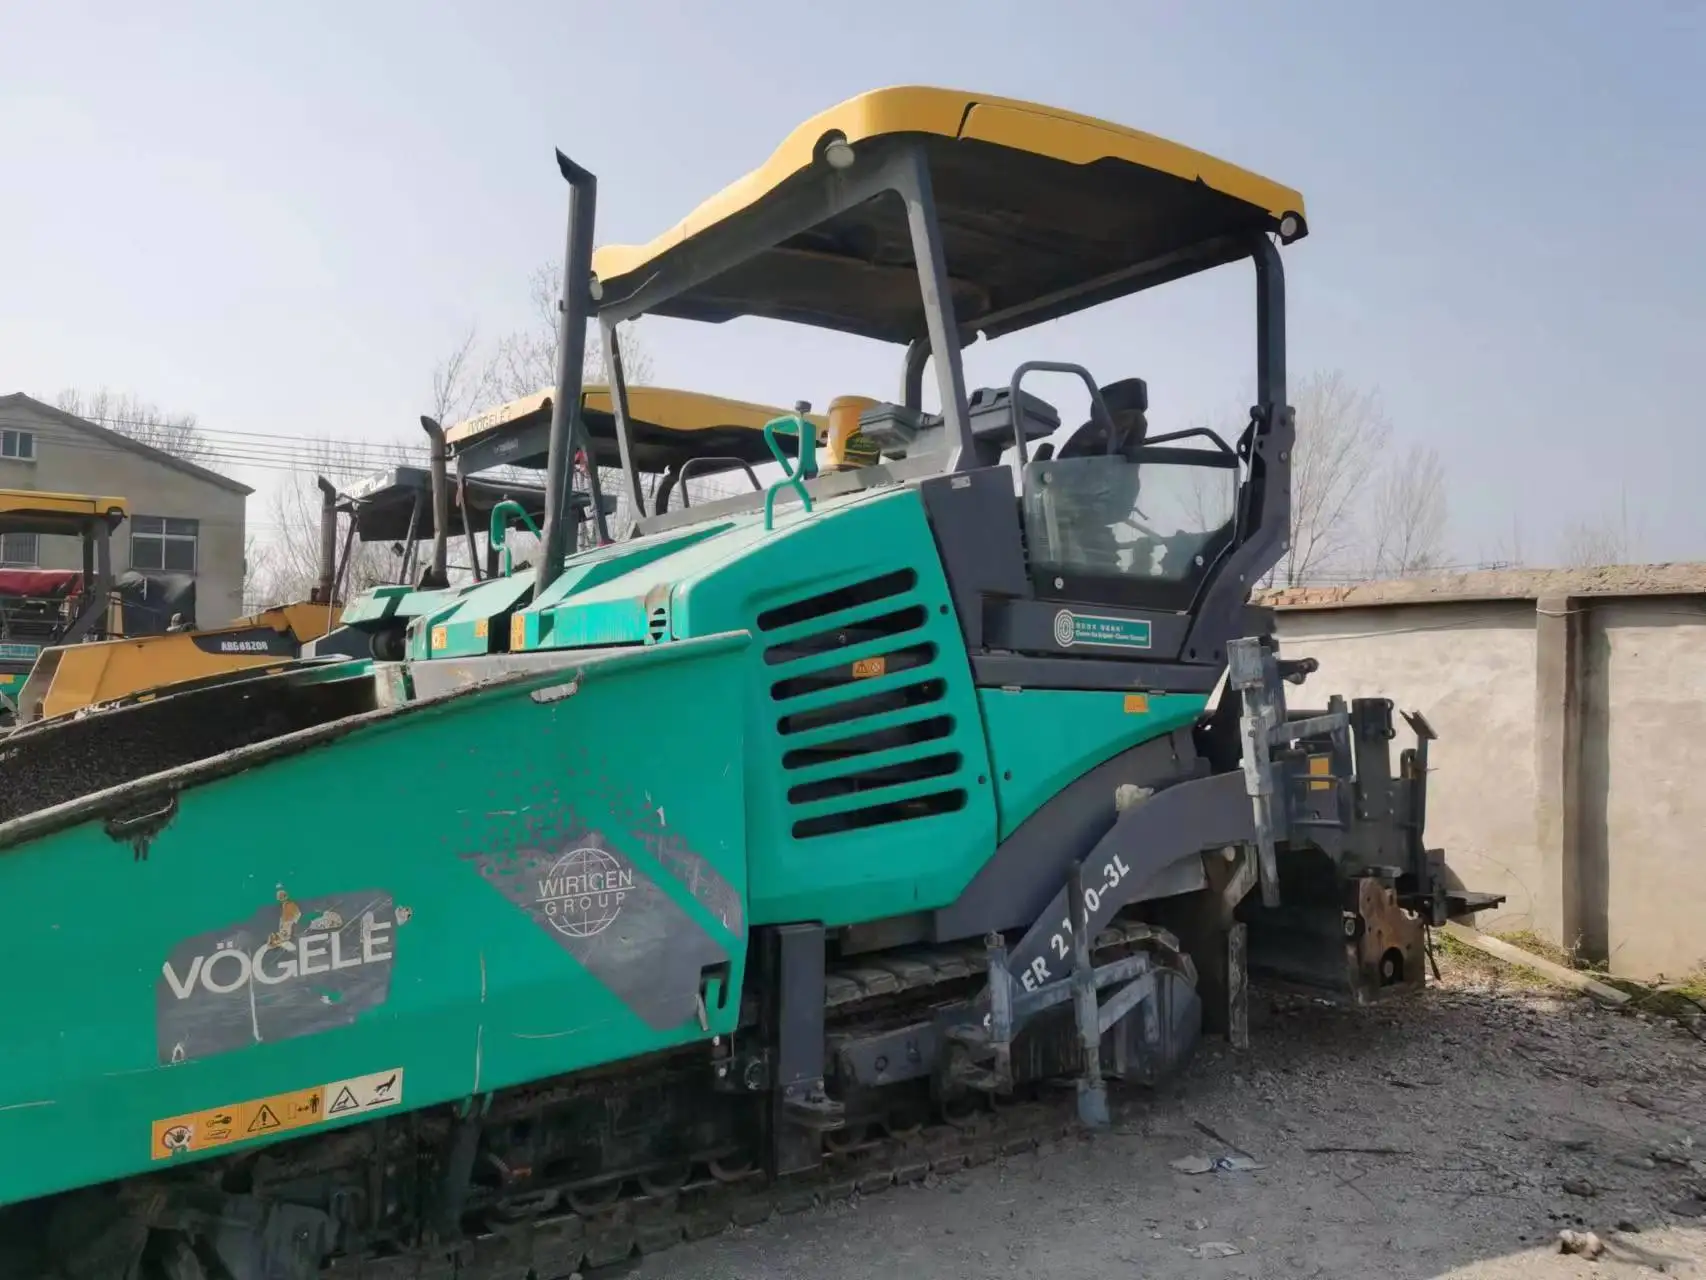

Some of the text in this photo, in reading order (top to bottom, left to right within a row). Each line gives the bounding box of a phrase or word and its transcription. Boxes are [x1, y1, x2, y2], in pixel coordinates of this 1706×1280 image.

[539, 868, 632, 897] WIRTGEN
[545, 892, 625, 916] GROUP
[162, 912, 392, 1000] VÖGELE
